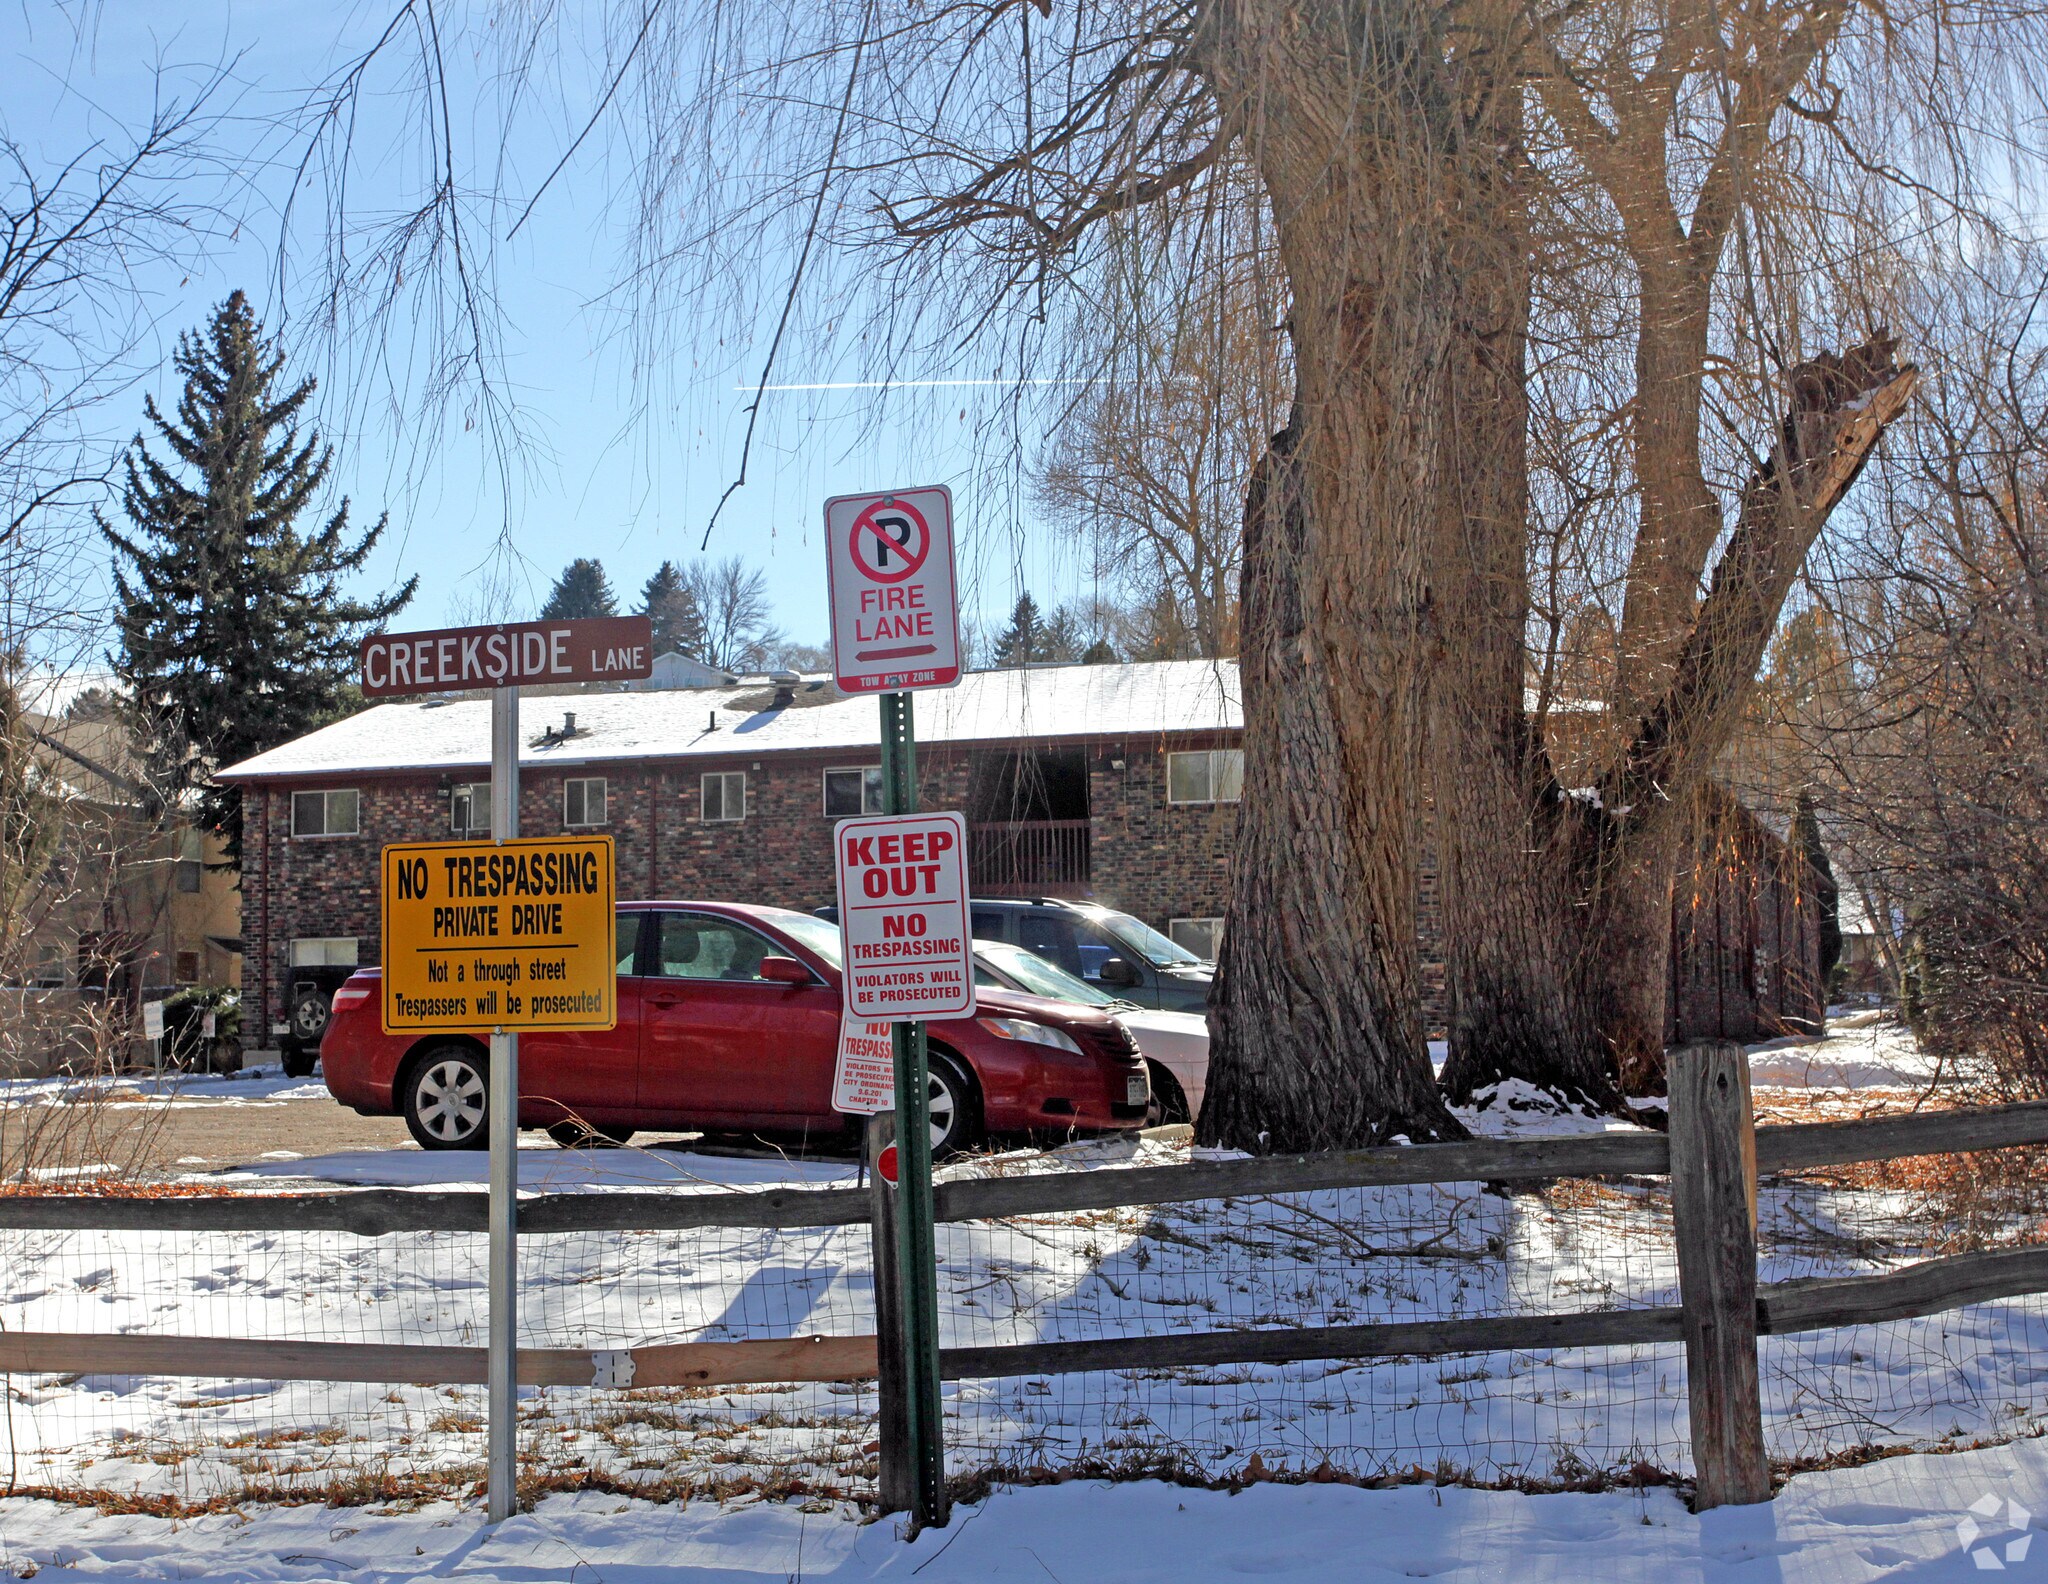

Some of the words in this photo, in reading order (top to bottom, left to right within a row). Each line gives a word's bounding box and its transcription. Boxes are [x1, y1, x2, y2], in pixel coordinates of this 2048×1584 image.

[860, 584, 925, 614] FIRE
[856, 612, 934, 642] LANE
[366, 629, 572, 688] CREEKSIDE
[591, 646, 645, 672] LANE
[861, 676, 880, 687] TOW
[912, 671, 936, 683] ZONE
[846, 831, 953, 867] KEEP
[398, 857, 429, 900] NO
[444, 851, 598, 898] TRESPASSING
[863, 864, 941, 899] OUT
[433, 905, 499, 937] PRIVATE
[511, 903, 562, 935] DRIVE
[883, 913, 927, 938] NO
[853, 938, 961, 960] TRESPASSING
[428, 958, 448, 983] Not
[457, 963, 465, 982] a
[474, 957, 520, 986] through
[529, 957, 566, 981] street
[855, 971, 925, 988] VIOLATORS
[930, 970, 962, 983] WILL
[395, 992, 467, 1021] Trespassers
[476, 991, 497, 1015] will
[506, 990, 522, 1014] be
[531, 987, 602, 1018] prosecuted
[858, 990, 874, 1003] BE
[879, 986, 961, 1002] PROSECUTED
[846, 1037, 893, 1059] TRESPASS
[844, 1070, 853, 1078] BE
[846, 1062, 881, 1073] VIOLATORS
[843, 1078, 858, 1086] CITY
[860, 1080, 895, 1091] ORDINANC
[848, 1096, 878, 1105] CHAPTER
